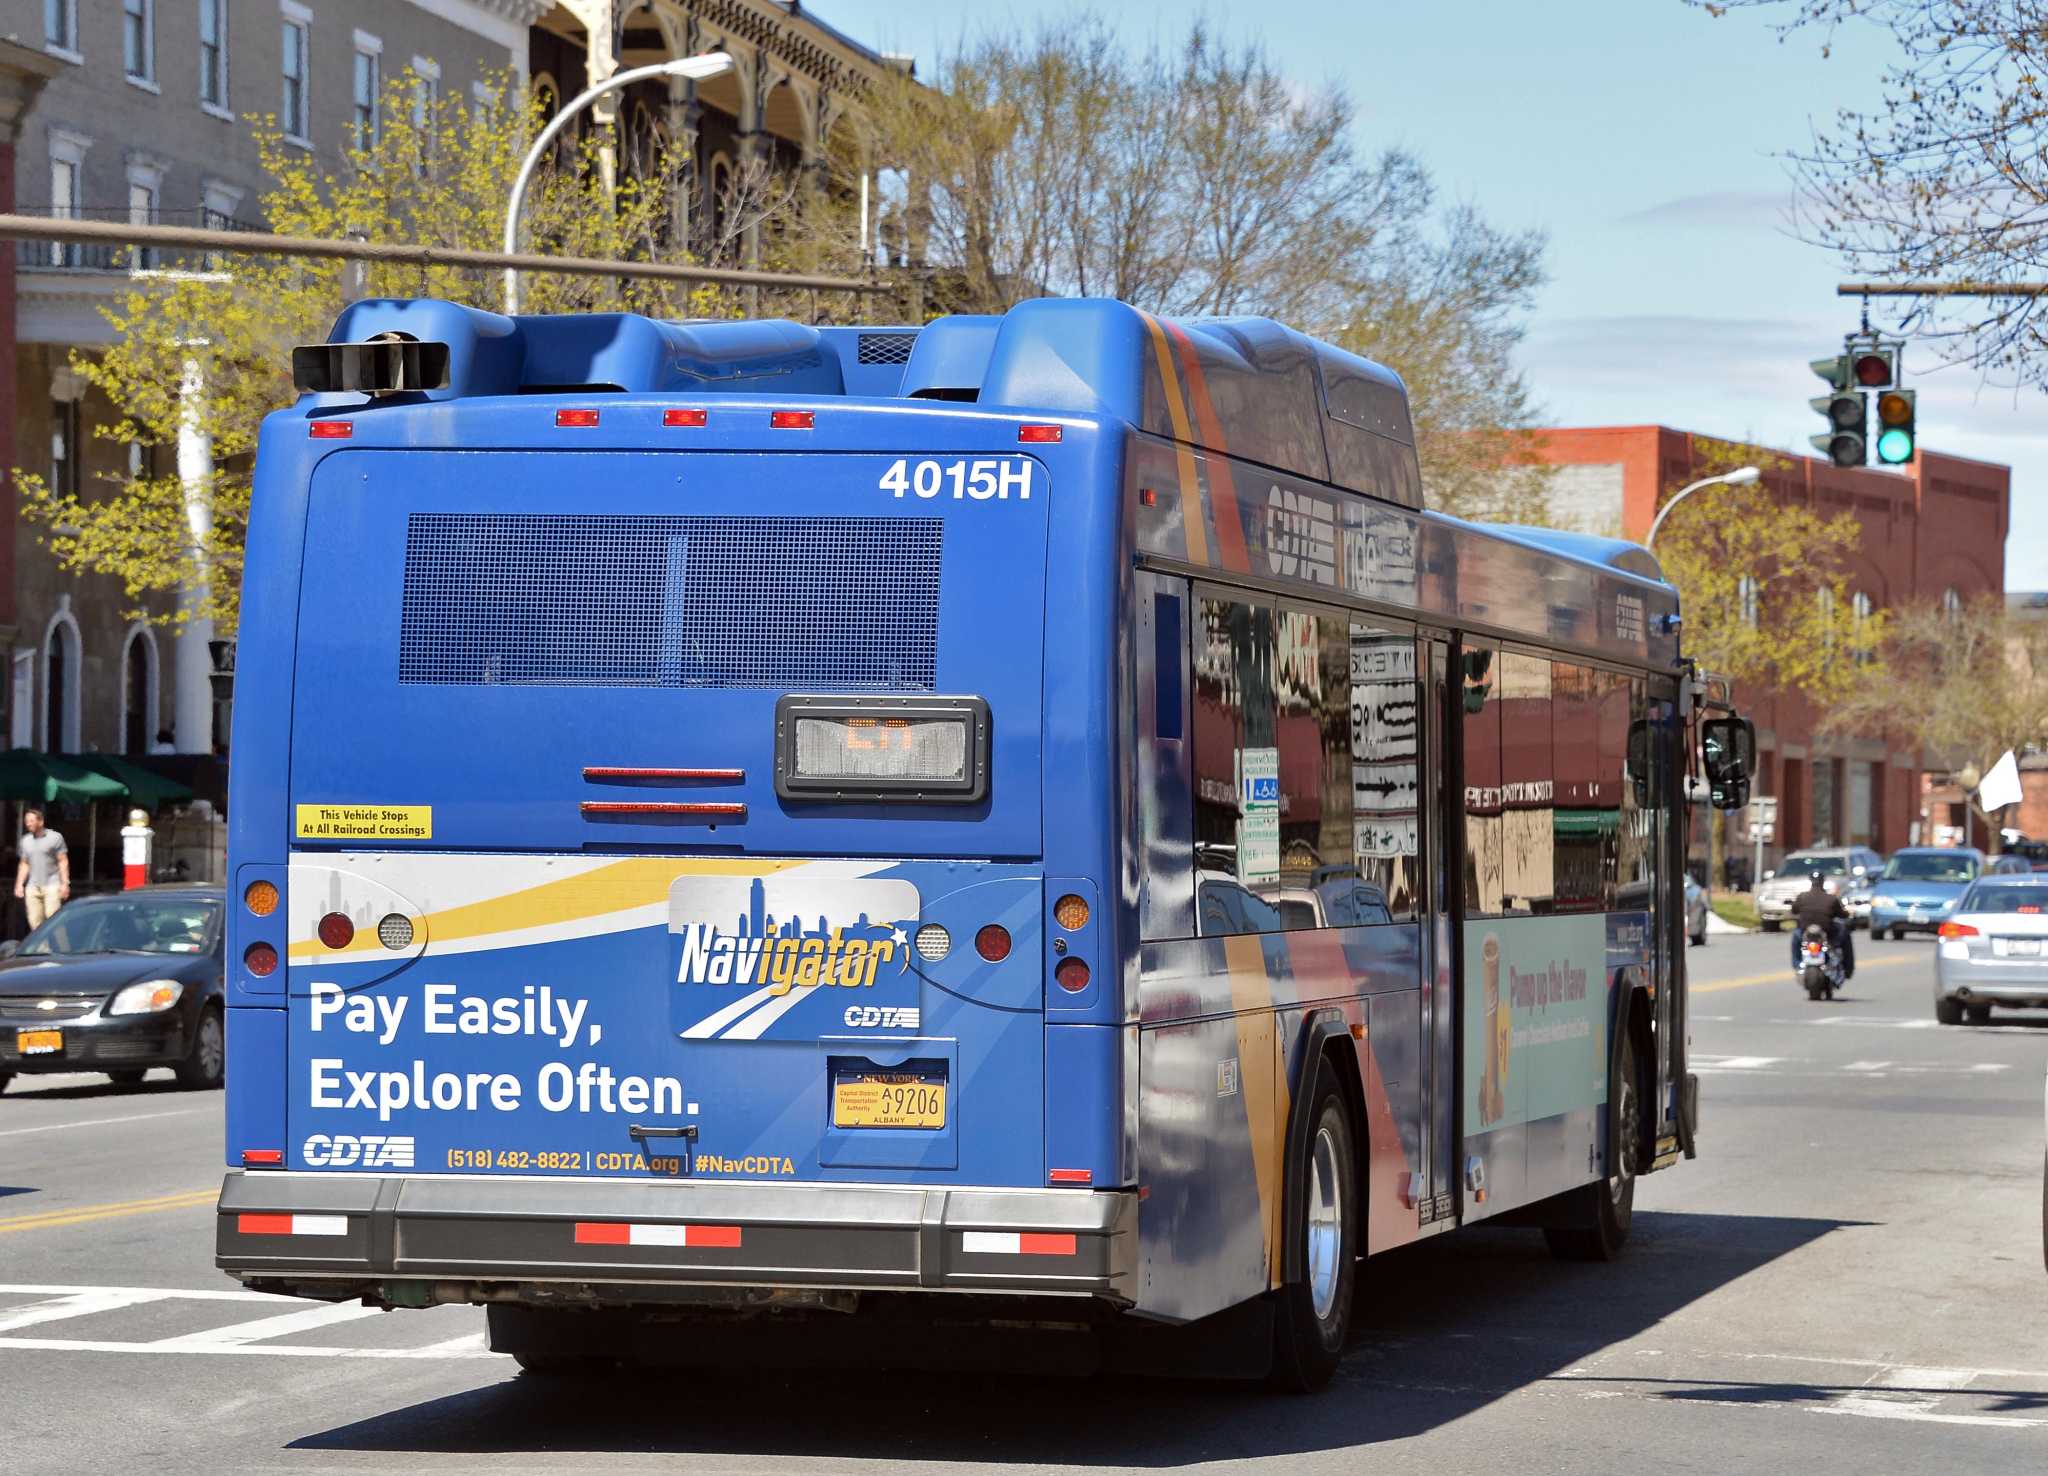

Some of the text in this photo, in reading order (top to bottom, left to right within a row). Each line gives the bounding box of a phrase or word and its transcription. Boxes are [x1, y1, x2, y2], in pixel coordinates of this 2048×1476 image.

[879, 460, 1032, 500] 4015H
[1267, 485, 1335, 586] CDTA
[303, 824, 426, 836] At All Railroad Crossings
[320, 810, 409, 822] This Vehicle Stops
[676, 922, 895, 996] Navigator
[310, 982, 602, 1048] Pay Easily,
[844, 1006, 920, 1029] CDTA
[311, 1058, 700, 1121] Explore Often.
[863, 1074, 921, 1084] NEW YORK
[894, 1088, 939, 1115] 9206
[303, 1135, 415, 1168] CDTA
[447, 1149, 796, 1176] (518) 482-8822 CDTA.org #NavCDTA
